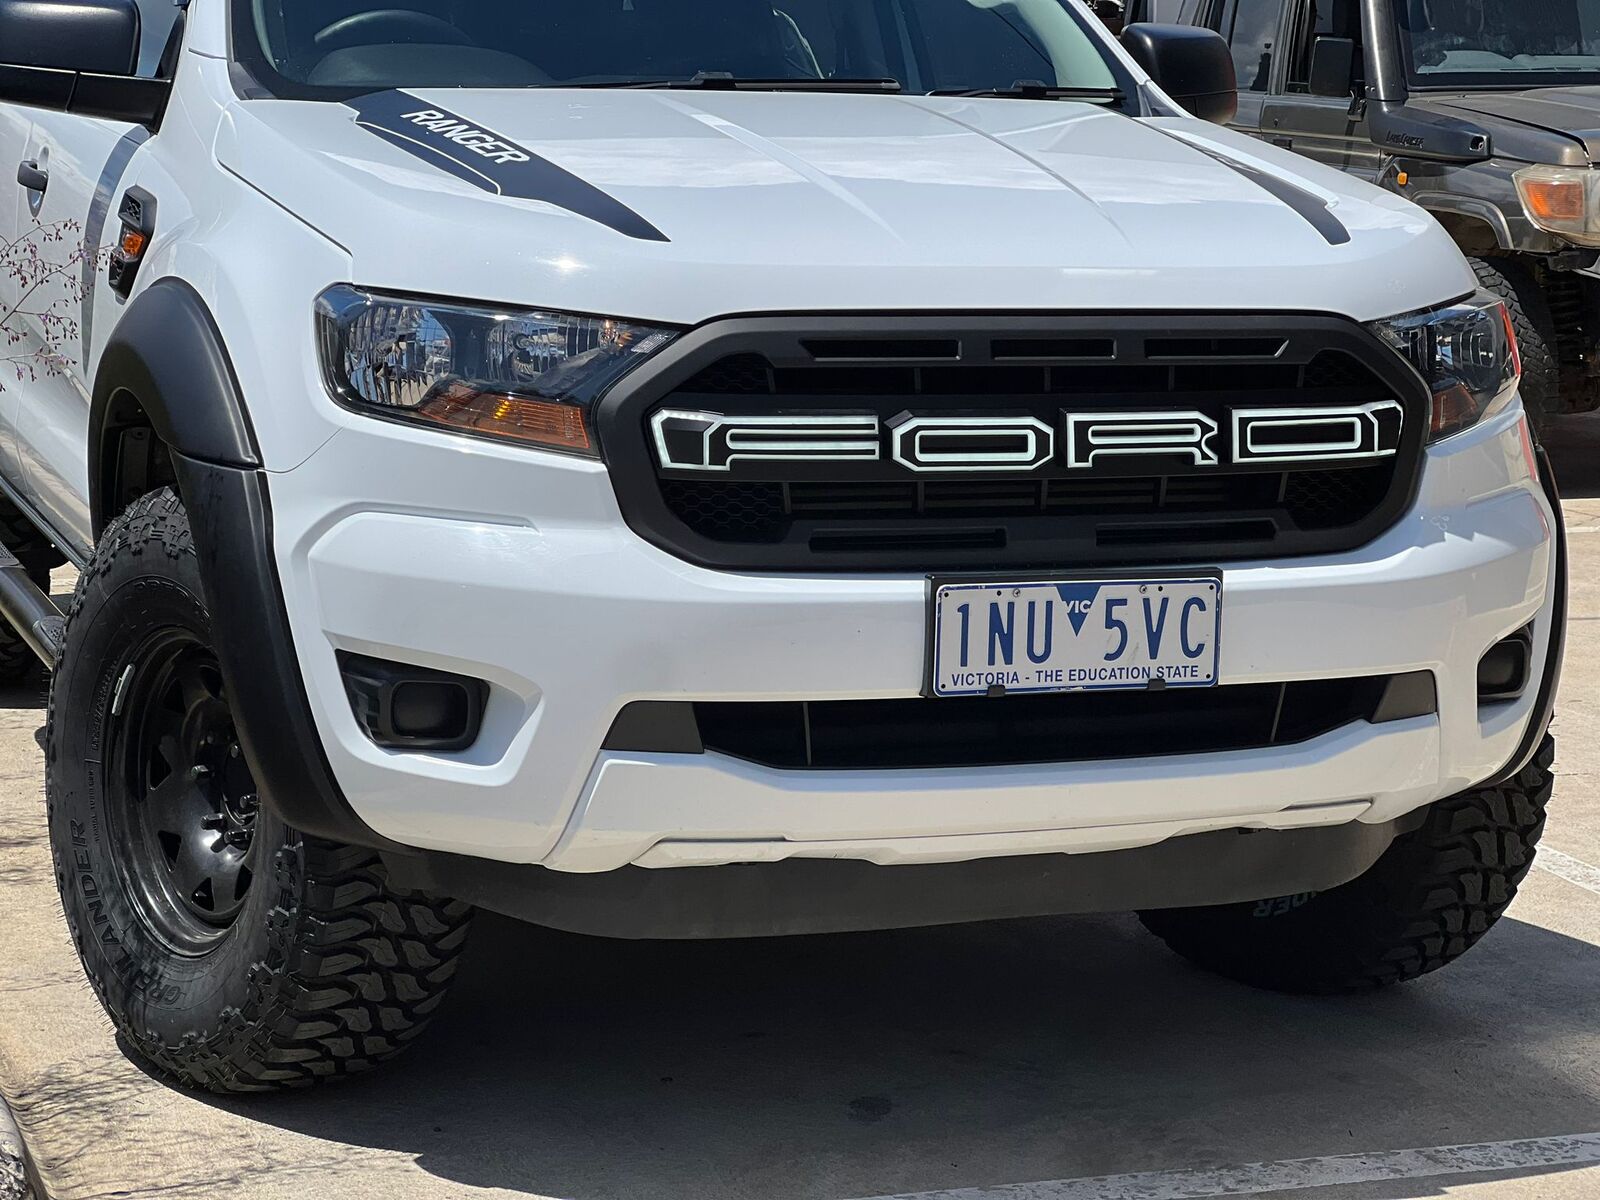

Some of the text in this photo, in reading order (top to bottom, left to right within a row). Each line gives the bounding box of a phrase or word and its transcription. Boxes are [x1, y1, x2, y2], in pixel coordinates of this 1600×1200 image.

[400, 109, 530, 164] RANGER
[649, 401, 1404, 473] FORD
[957, 596, 1206, 667] 1NU 5VC
[1064, 600, 1091, 614] VIC
[951, 671, 1019, 686] VICTORIA
[1036, 669, 1063, 683] THE
[1069, 667, 1150, 682] EDUCATION
[1156, 665, 1199, 679] STATE
